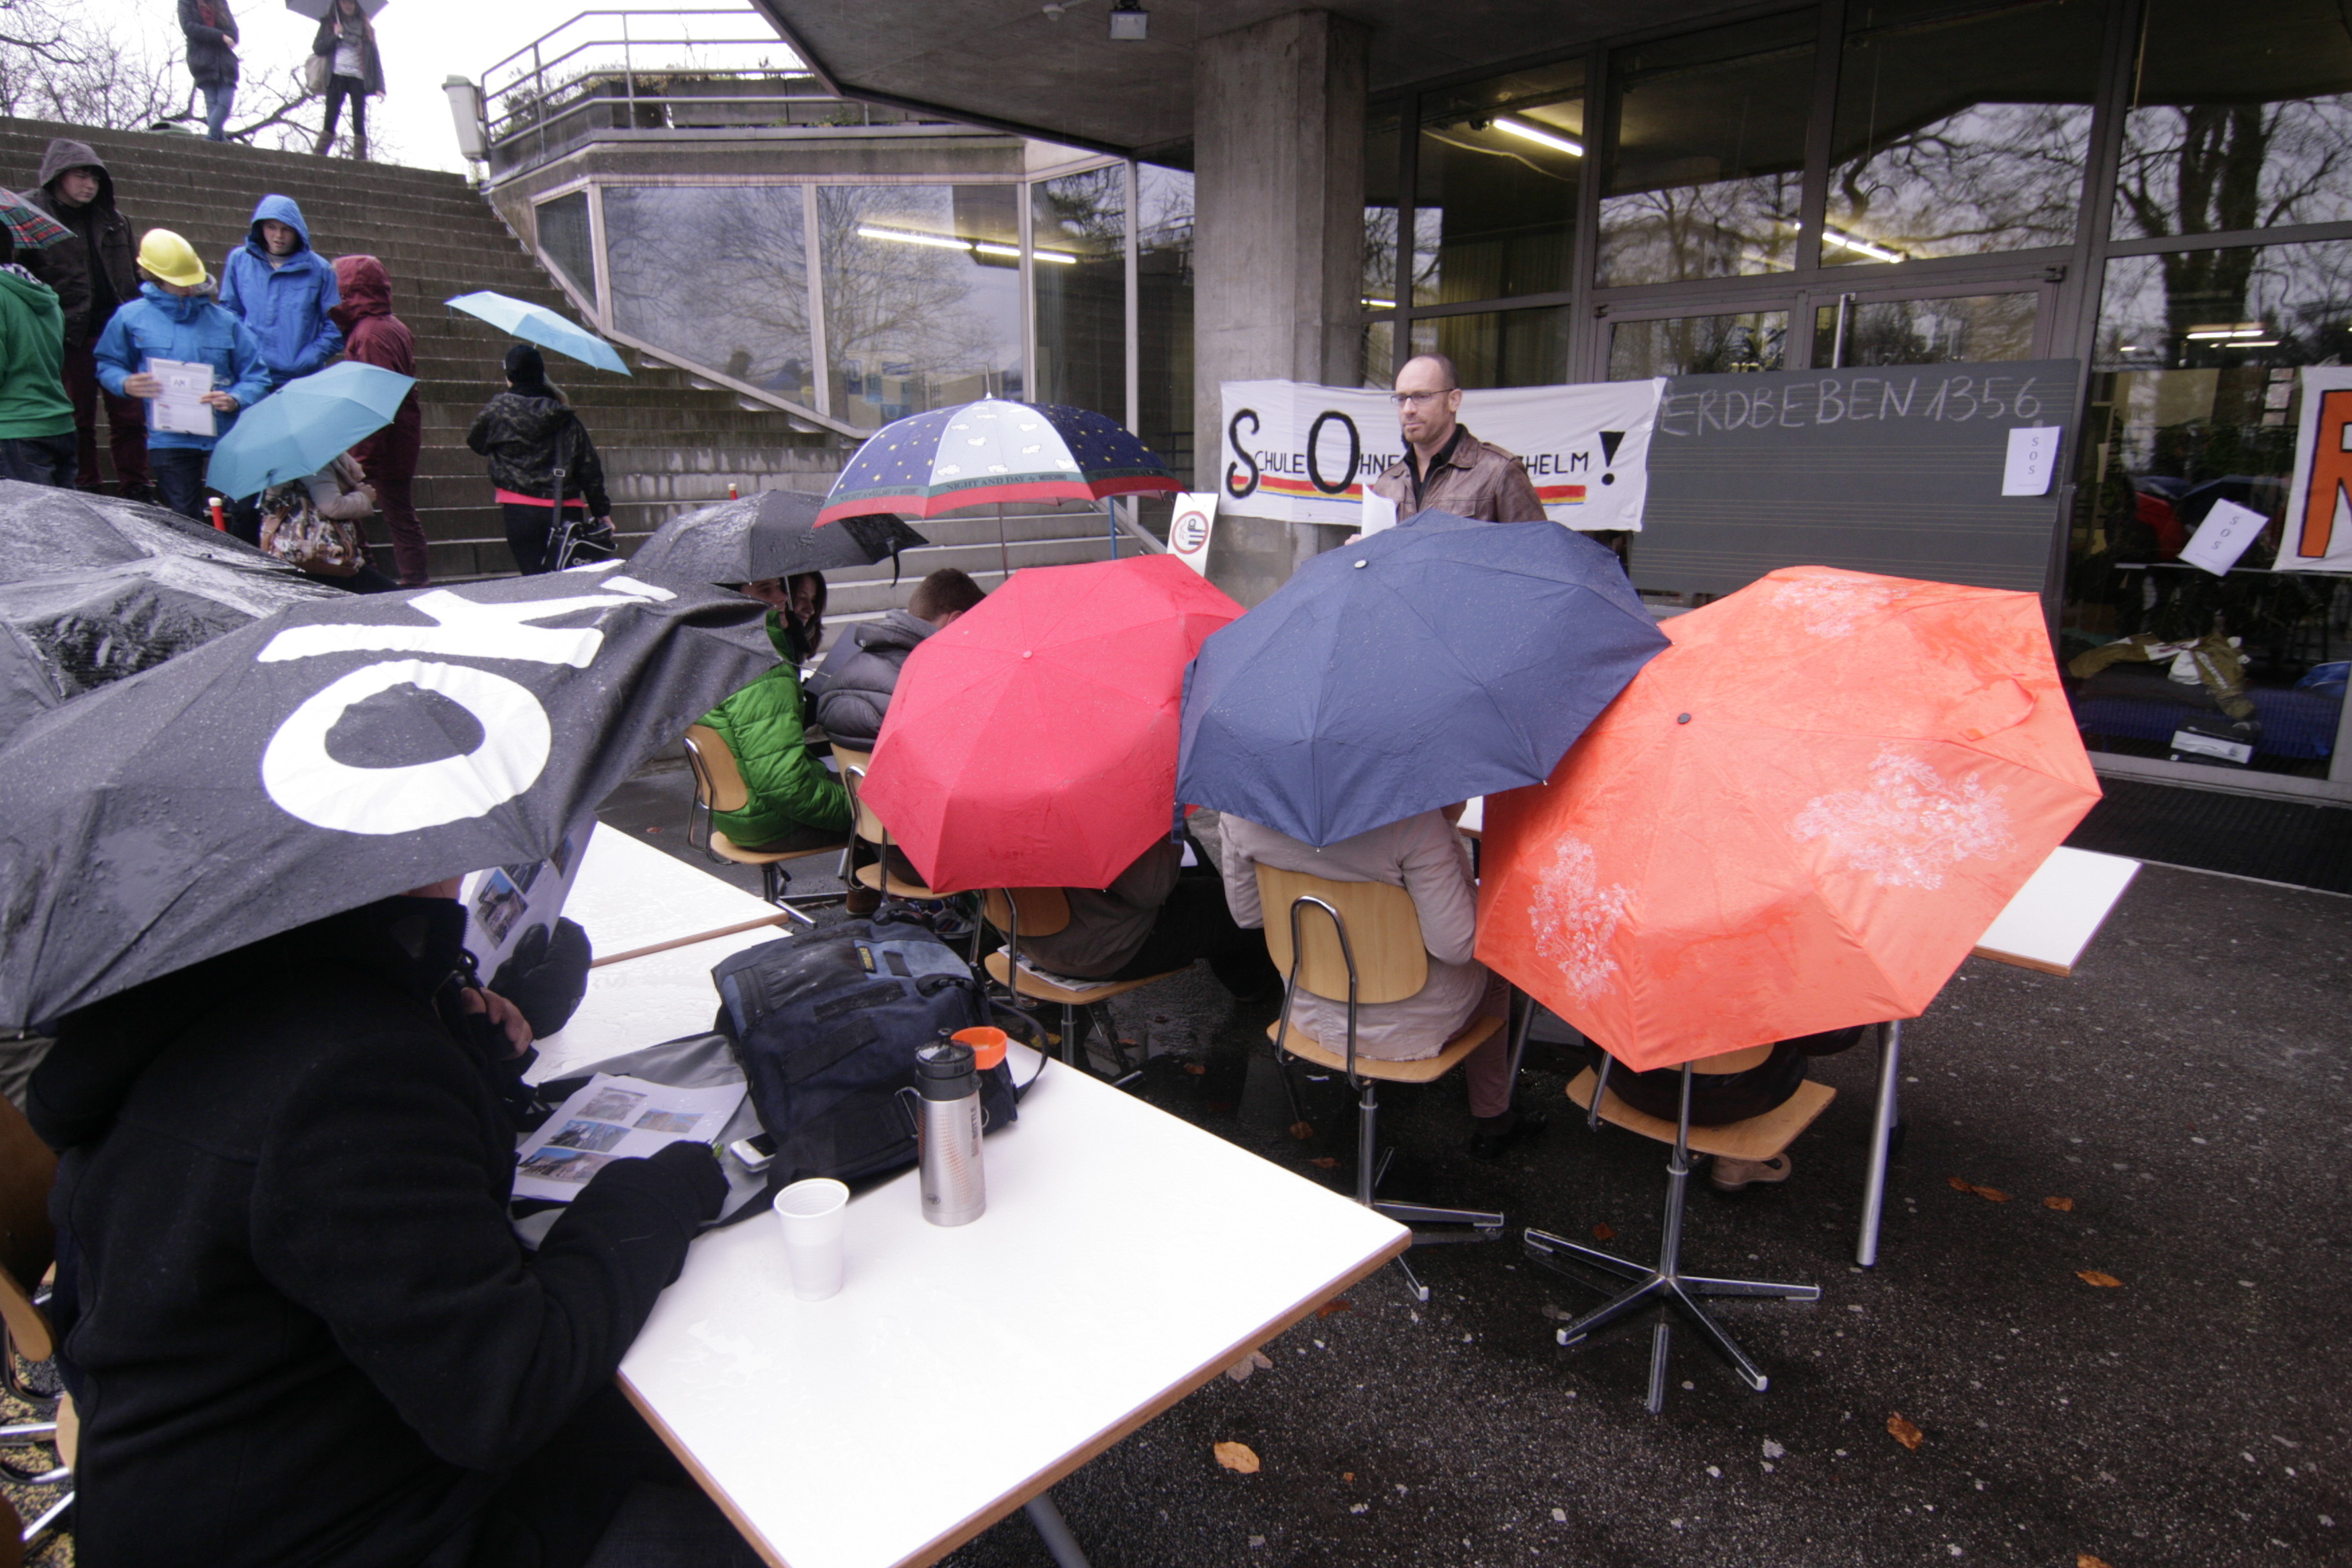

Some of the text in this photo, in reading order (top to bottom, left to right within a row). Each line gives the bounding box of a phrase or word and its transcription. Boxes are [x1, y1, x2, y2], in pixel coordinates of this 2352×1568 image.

[1661, 375, 2041, 436] ERDBEBEN 1356
[946, 480, 978, 491] NIGHT
[981, 478, 1003, 487] AND
[1006, 475, 1026, 484] DAY
